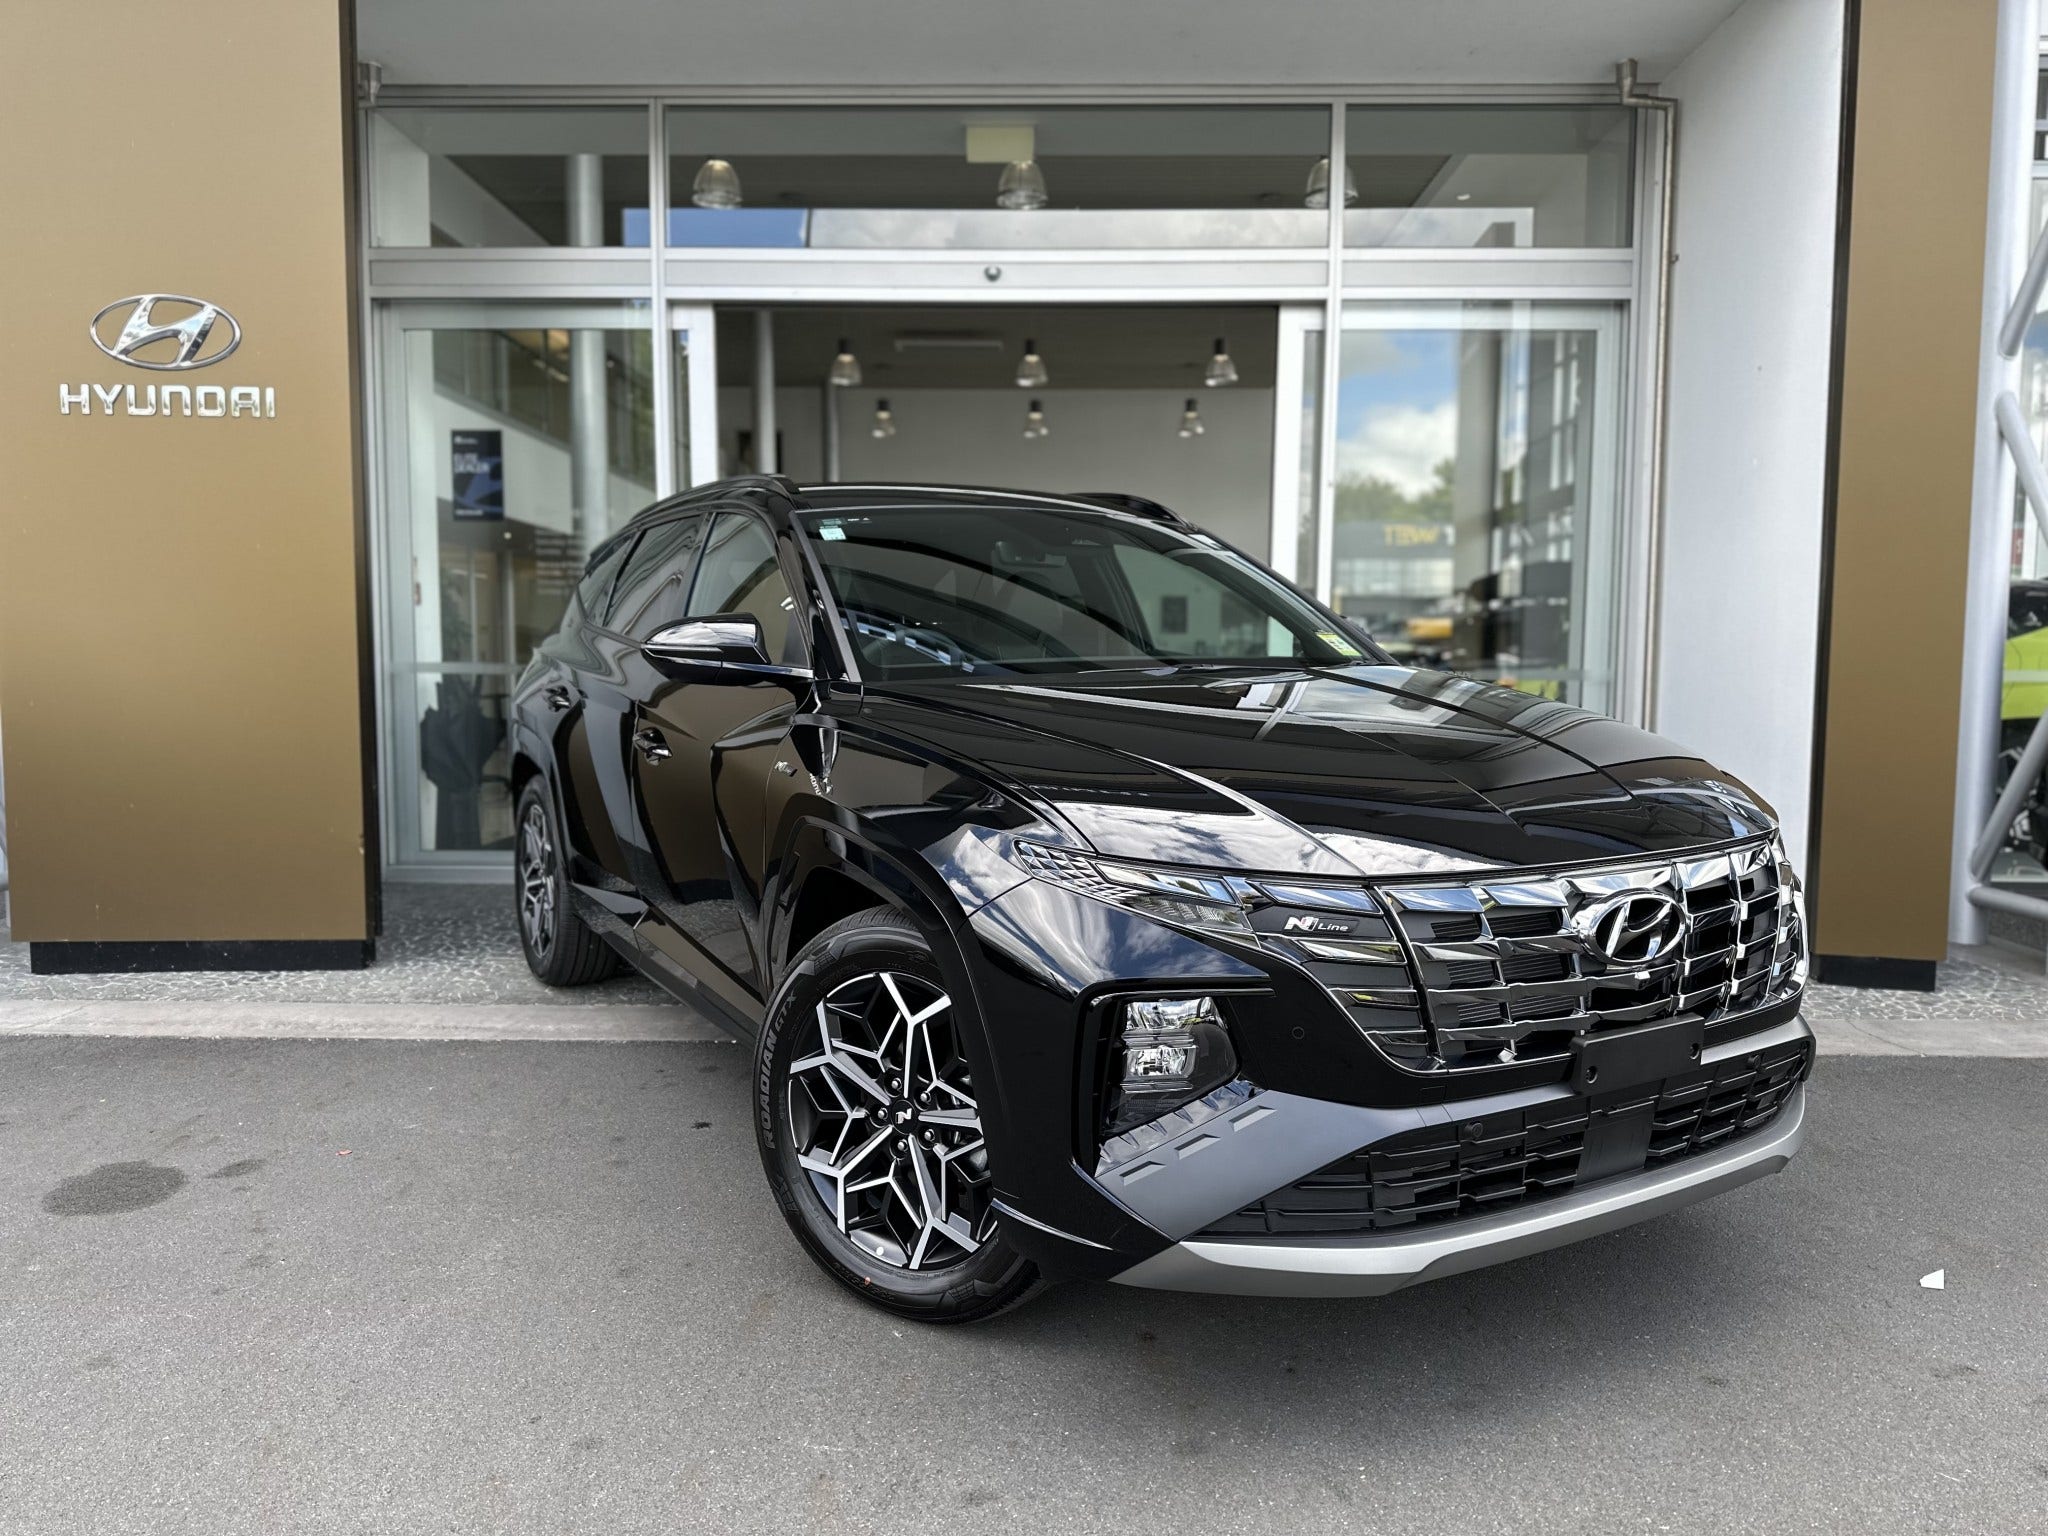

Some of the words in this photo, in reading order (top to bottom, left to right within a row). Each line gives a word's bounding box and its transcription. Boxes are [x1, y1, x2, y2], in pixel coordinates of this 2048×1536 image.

[59, 383, 276, 418] HYUNDAI
[1318, 923, 1349, 932] Line
[759, 1028, 778, 1149] ROADIAN
[774, 990, 797, 1032] GTX
